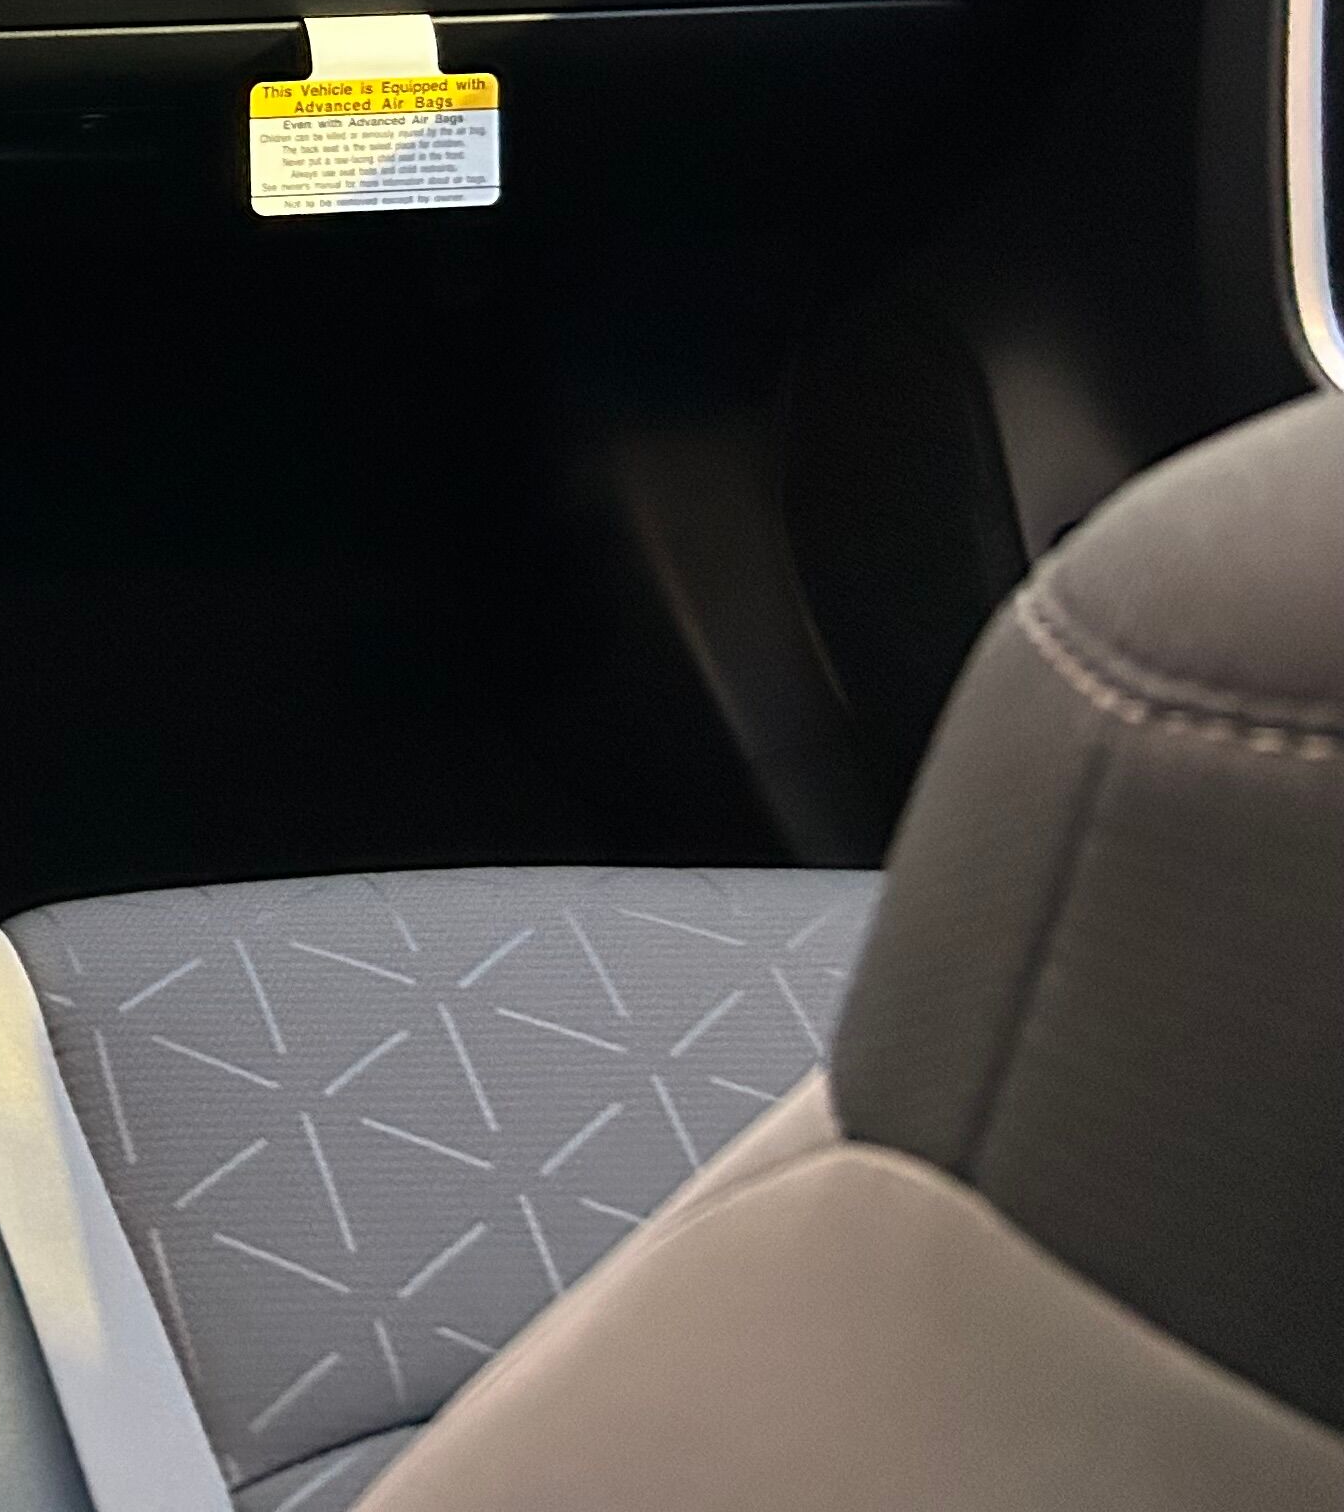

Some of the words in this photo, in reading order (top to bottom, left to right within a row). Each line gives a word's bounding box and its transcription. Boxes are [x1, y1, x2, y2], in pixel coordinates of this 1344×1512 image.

[263, 85, 292, 98] This
[300, 83, 352, 97] Vehicle
[360, 82, 373, 95] is
[381, 79, 448, 95] Equipped
[456, 77, 485, 90] with
[294, 99, 371, 113] Advanced
[382, 98, 403, 110] Air
[415, 96, 452, 109] Bags
[283, 119, 311, 129] Even
[318, 118, 341, 128] with
[348, 116, 405, 127] Advanced
[412, 115, 428, 124] Air
[434, 113, 463, 125] Bags
